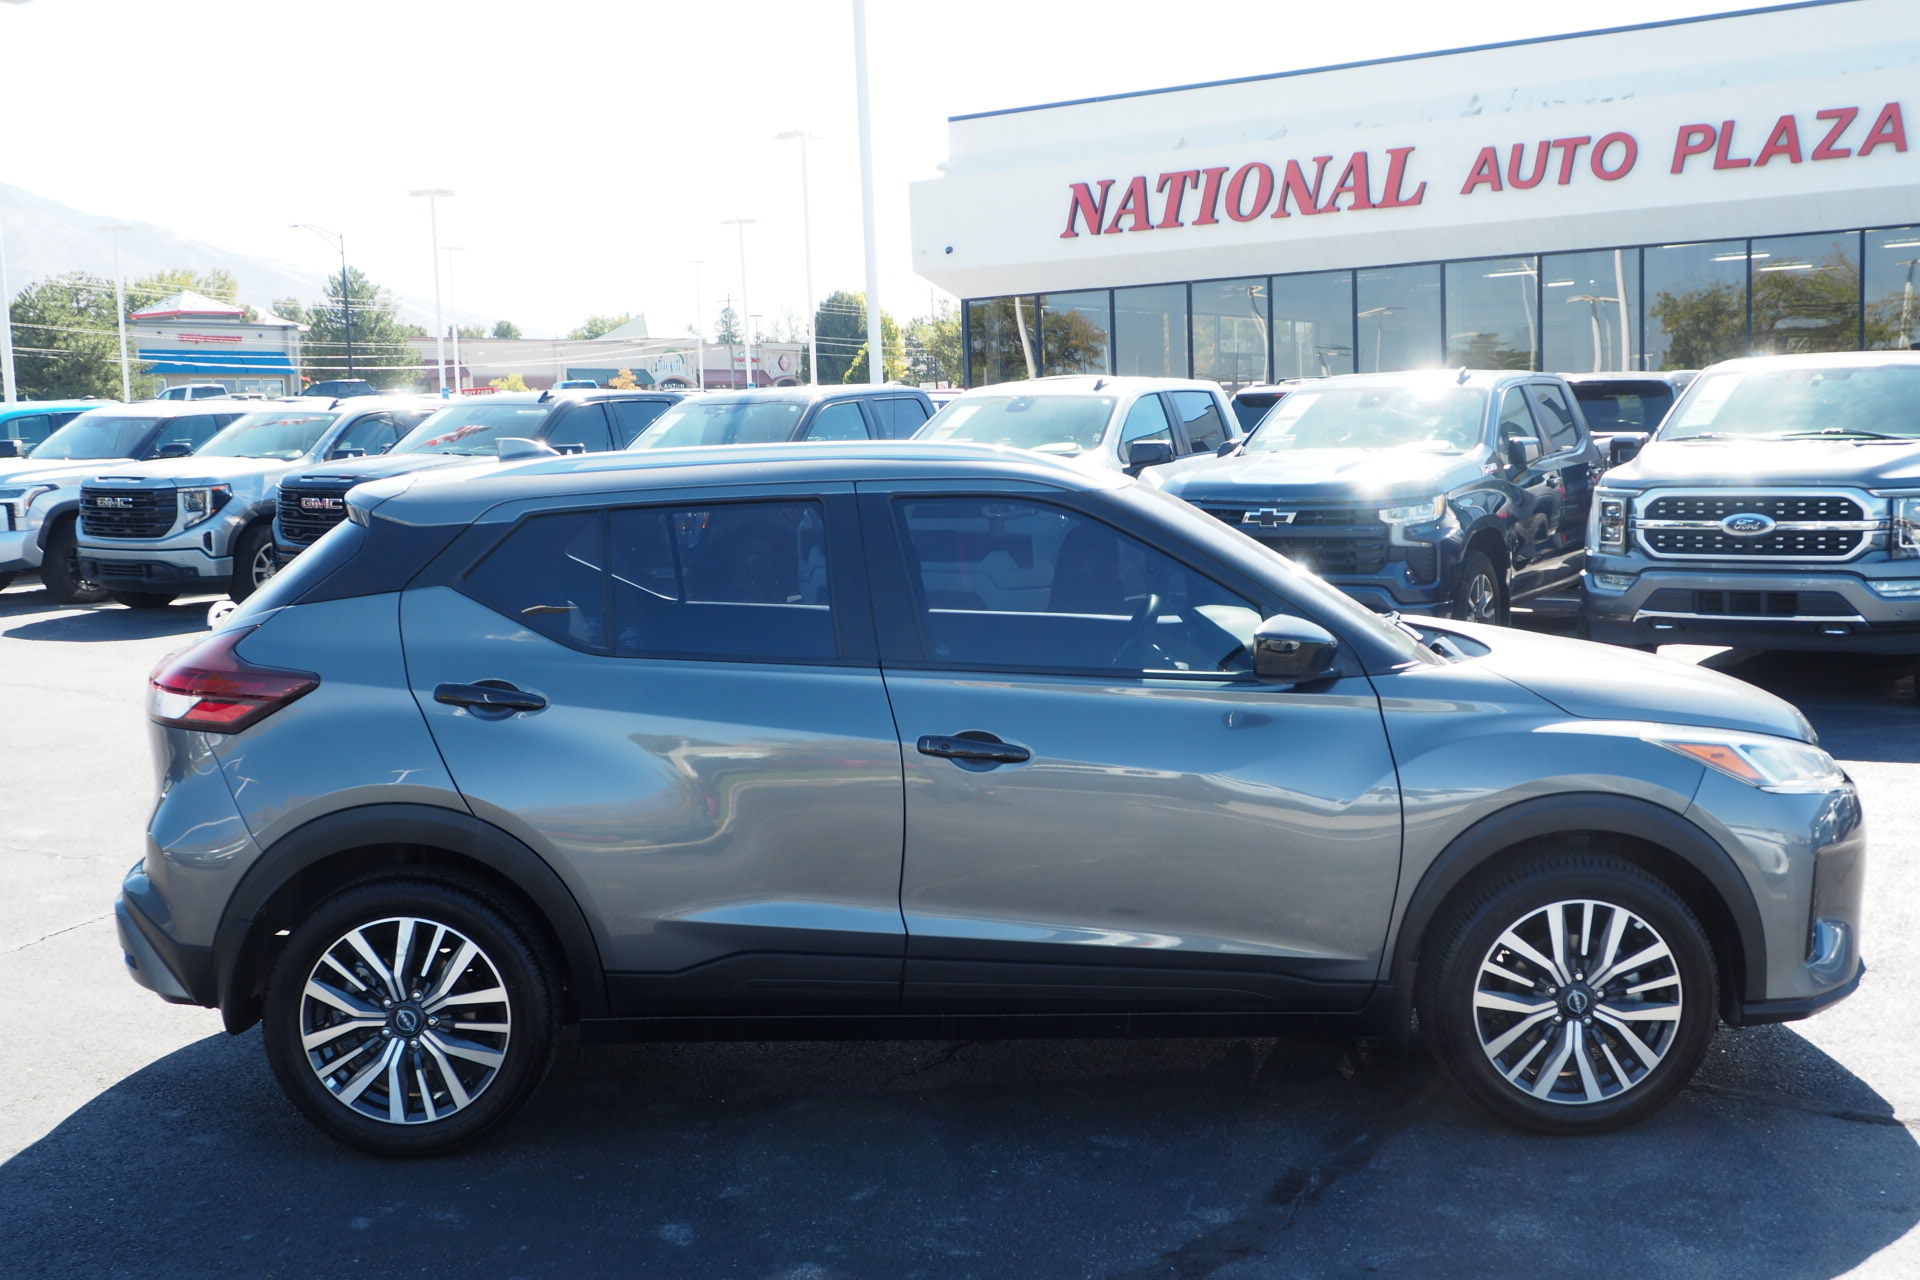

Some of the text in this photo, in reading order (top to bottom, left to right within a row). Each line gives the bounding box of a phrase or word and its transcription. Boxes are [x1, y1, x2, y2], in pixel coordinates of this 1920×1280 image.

[1061, 101, 1908, 239] NATIONAL AUTO PLAZA
[97, 497, 133, 508] GMC
[301, 497, 343, 509] GMC
[1733, 518, 1761, 530] Ford
